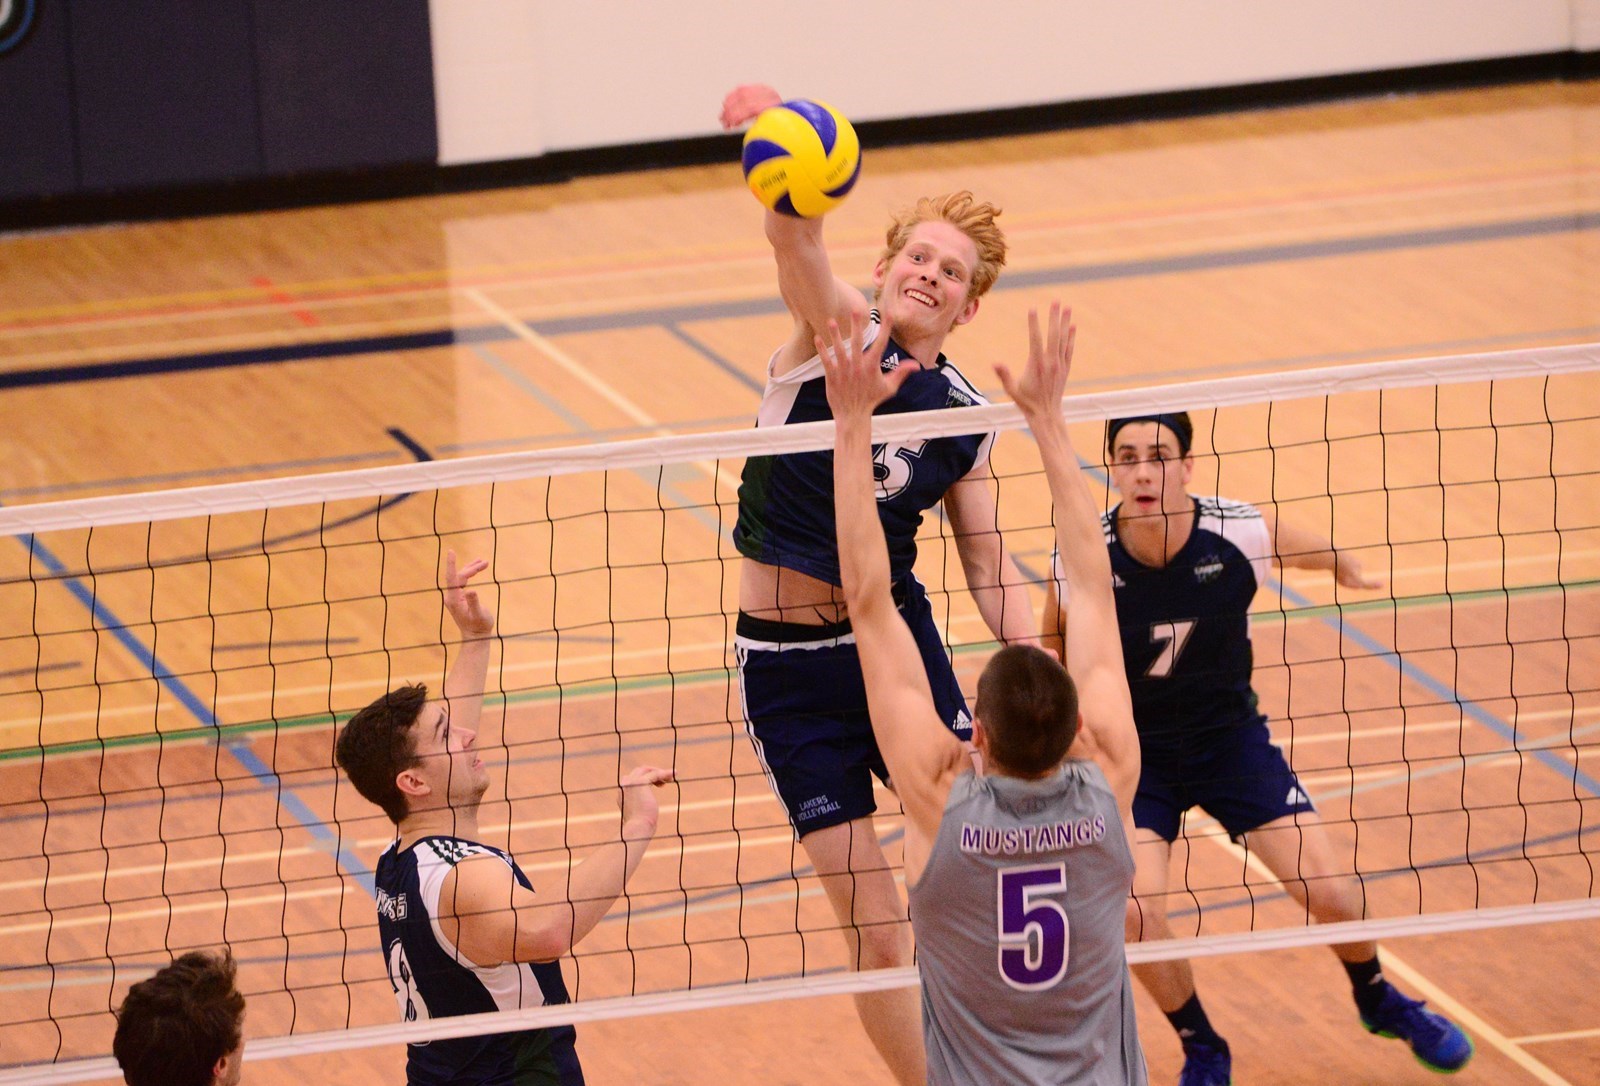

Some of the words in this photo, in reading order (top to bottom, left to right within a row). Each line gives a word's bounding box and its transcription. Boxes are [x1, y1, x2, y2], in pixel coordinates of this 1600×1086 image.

[1144, 617, 1199, 678] 7
[799, 794, 828, 811] LAKERS
[961, 812, 1106, 855] MUSTANGS
[997, 861, 1070, 991] 5
